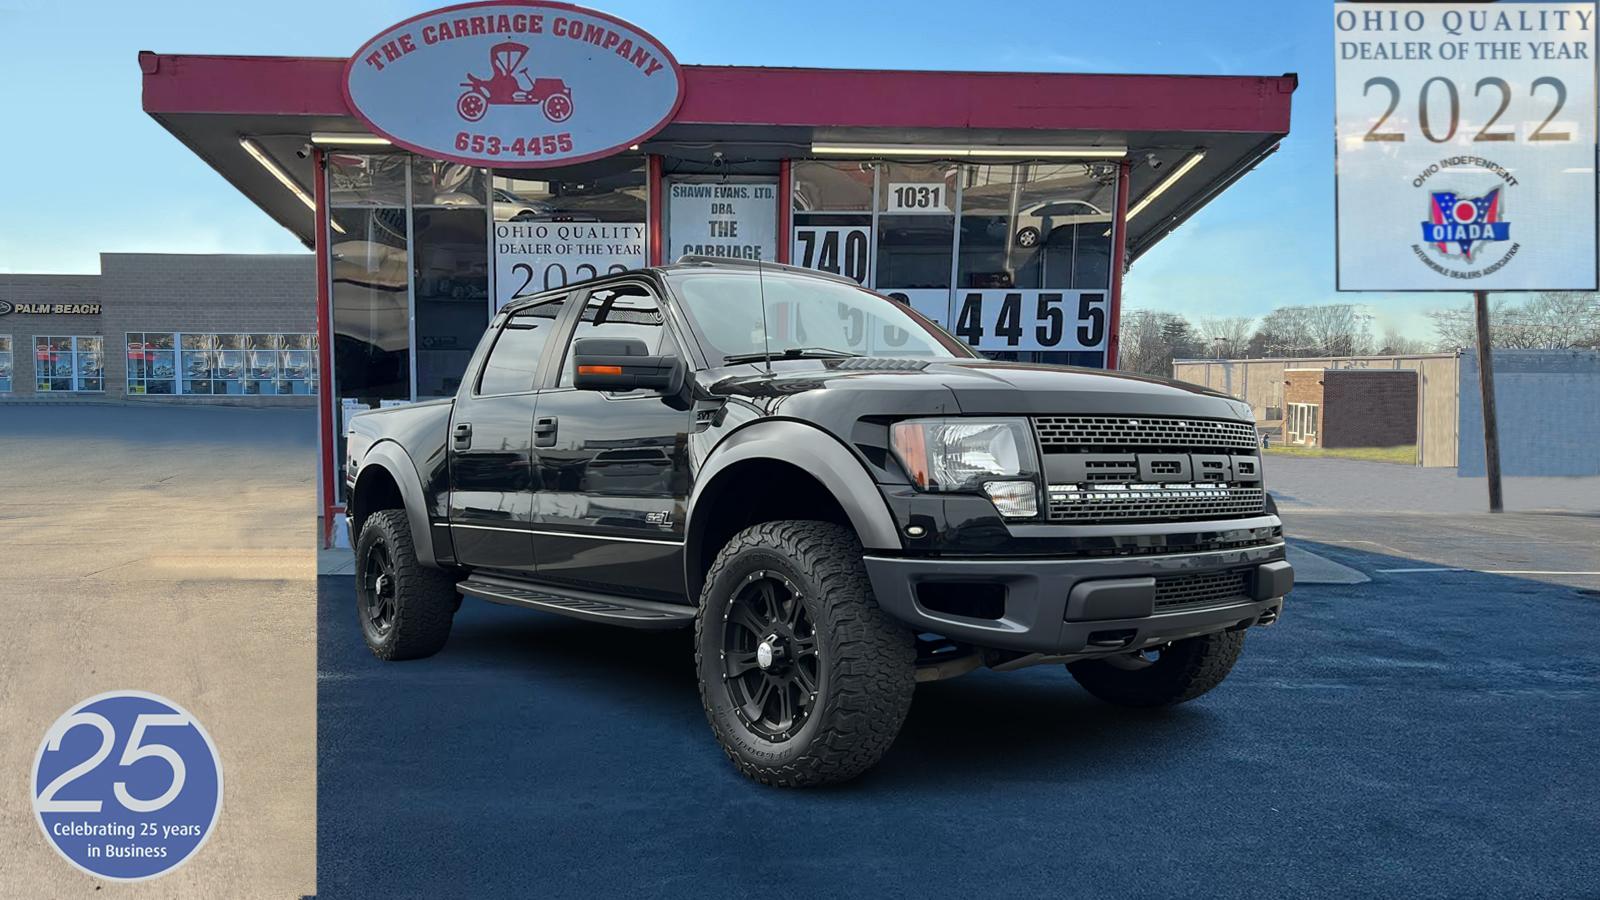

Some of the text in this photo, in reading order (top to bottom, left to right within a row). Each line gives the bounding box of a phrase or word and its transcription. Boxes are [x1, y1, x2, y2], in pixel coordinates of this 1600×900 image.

[1337, 10, 1592, 35] OHIO QUALITY
[366, 14, 663, 77] THE CARRIAGE COMPANY
[1340, 42, 1588, 60] DEALER OF THE YEAR
[1363, 76, 1570, 143] 2022
[455, 132, 573, 157] 653-4455
[1413, 156, 1519, 188] OHIO INDEPENDENT
[673, 186, 712, 198] SHAWN
[894, 186, 940, 209] 1031
[711, 203, 736, 215] DBA.
[497, 226, 644, 241] OHIO QUALITY
[709, 221, 738, 237] THE
[1433, 224, 1495, 240] OIADA
[500, 244, 641, 255] DEALER OF THE YEAR
[797, 230, 868, 285] 740
[511, 263, 629, 299] 20
[1450, 270, 1482, 280] DEALERS
[15, 304, 50, 314] PALM
[54, 304, 100, 314] BEACH
[1074, 453, 1260, 483] FORD
